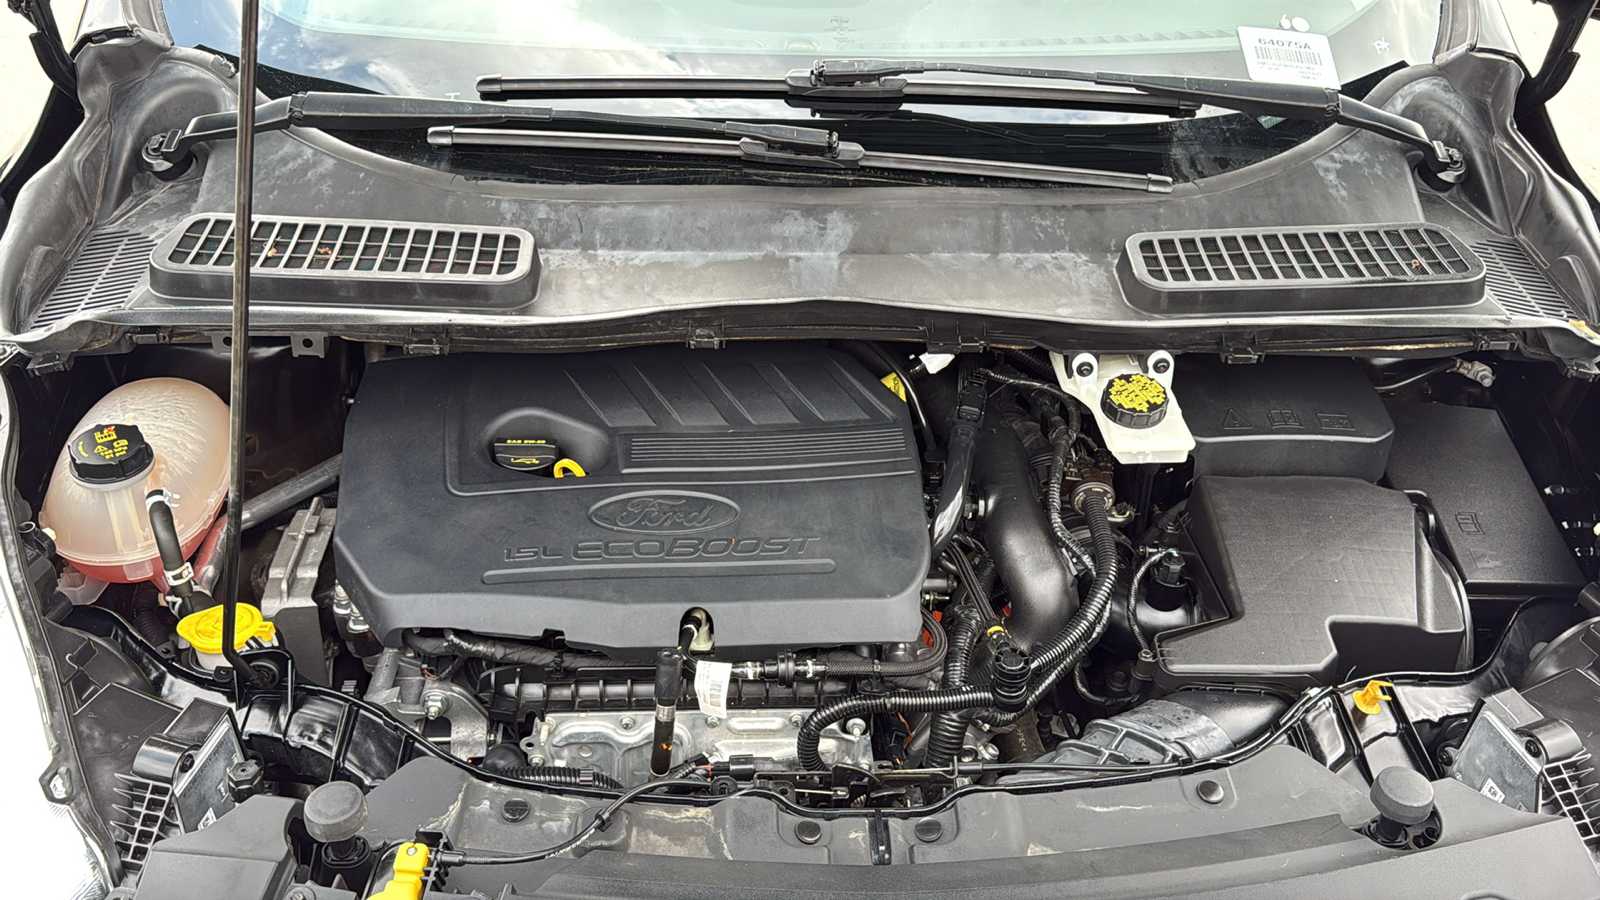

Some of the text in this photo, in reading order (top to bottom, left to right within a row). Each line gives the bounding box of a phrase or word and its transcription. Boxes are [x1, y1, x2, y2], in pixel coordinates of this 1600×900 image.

[1258, 38, 1311, 50] 64075A
[614, 497, 713, 528] Ford
[504, 536, 821, 562] 1.5L ECOBOOST
